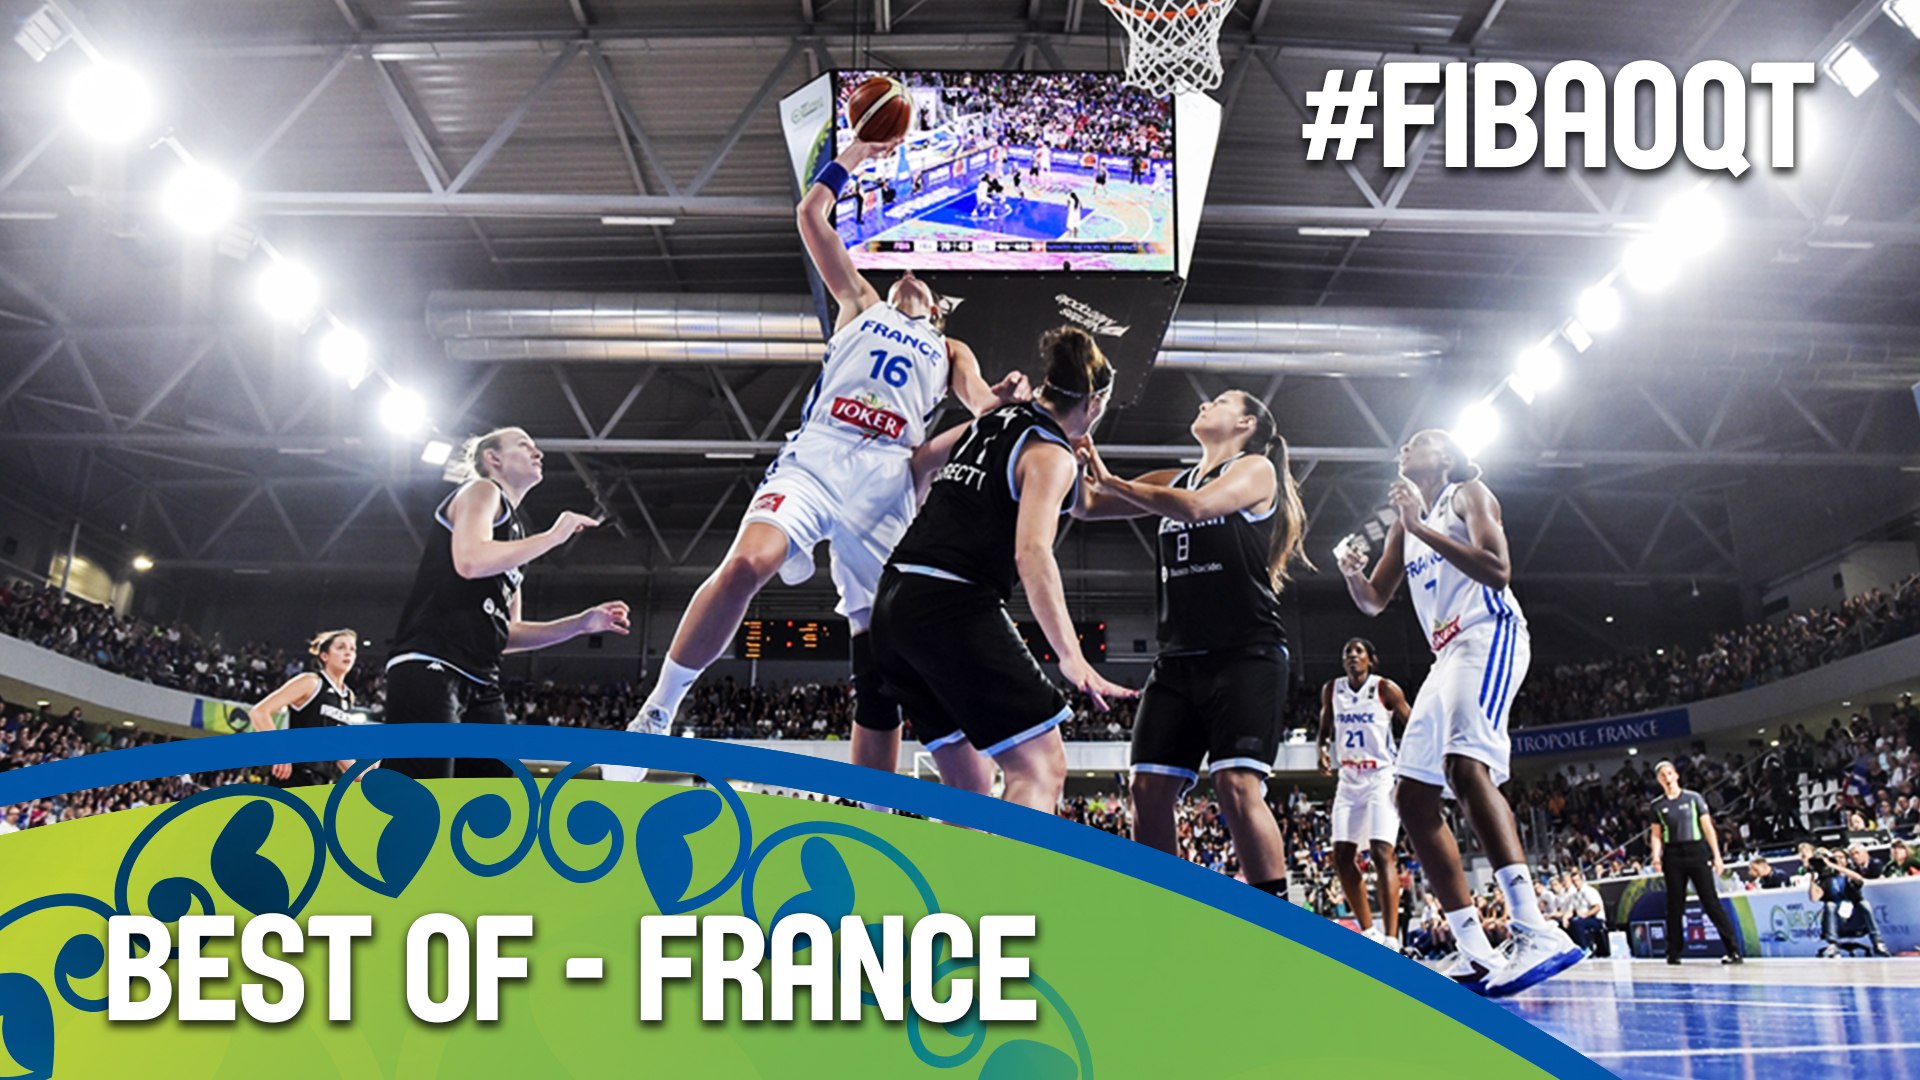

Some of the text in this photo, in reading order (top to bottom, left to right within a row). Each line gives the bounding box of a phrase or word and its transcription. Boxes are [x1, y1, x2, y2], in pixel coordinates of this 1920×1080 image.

[860, 320, 942, 367] FRANCE
[869, 349, 913, 388] 16
[836, 402, 898, 436] JOKER
[1177, 533, 1189, 561] 8
[1345, 730, 1365, 748] 21
[1515, 719, 1660, 752] TROPOLE, FRANCE
